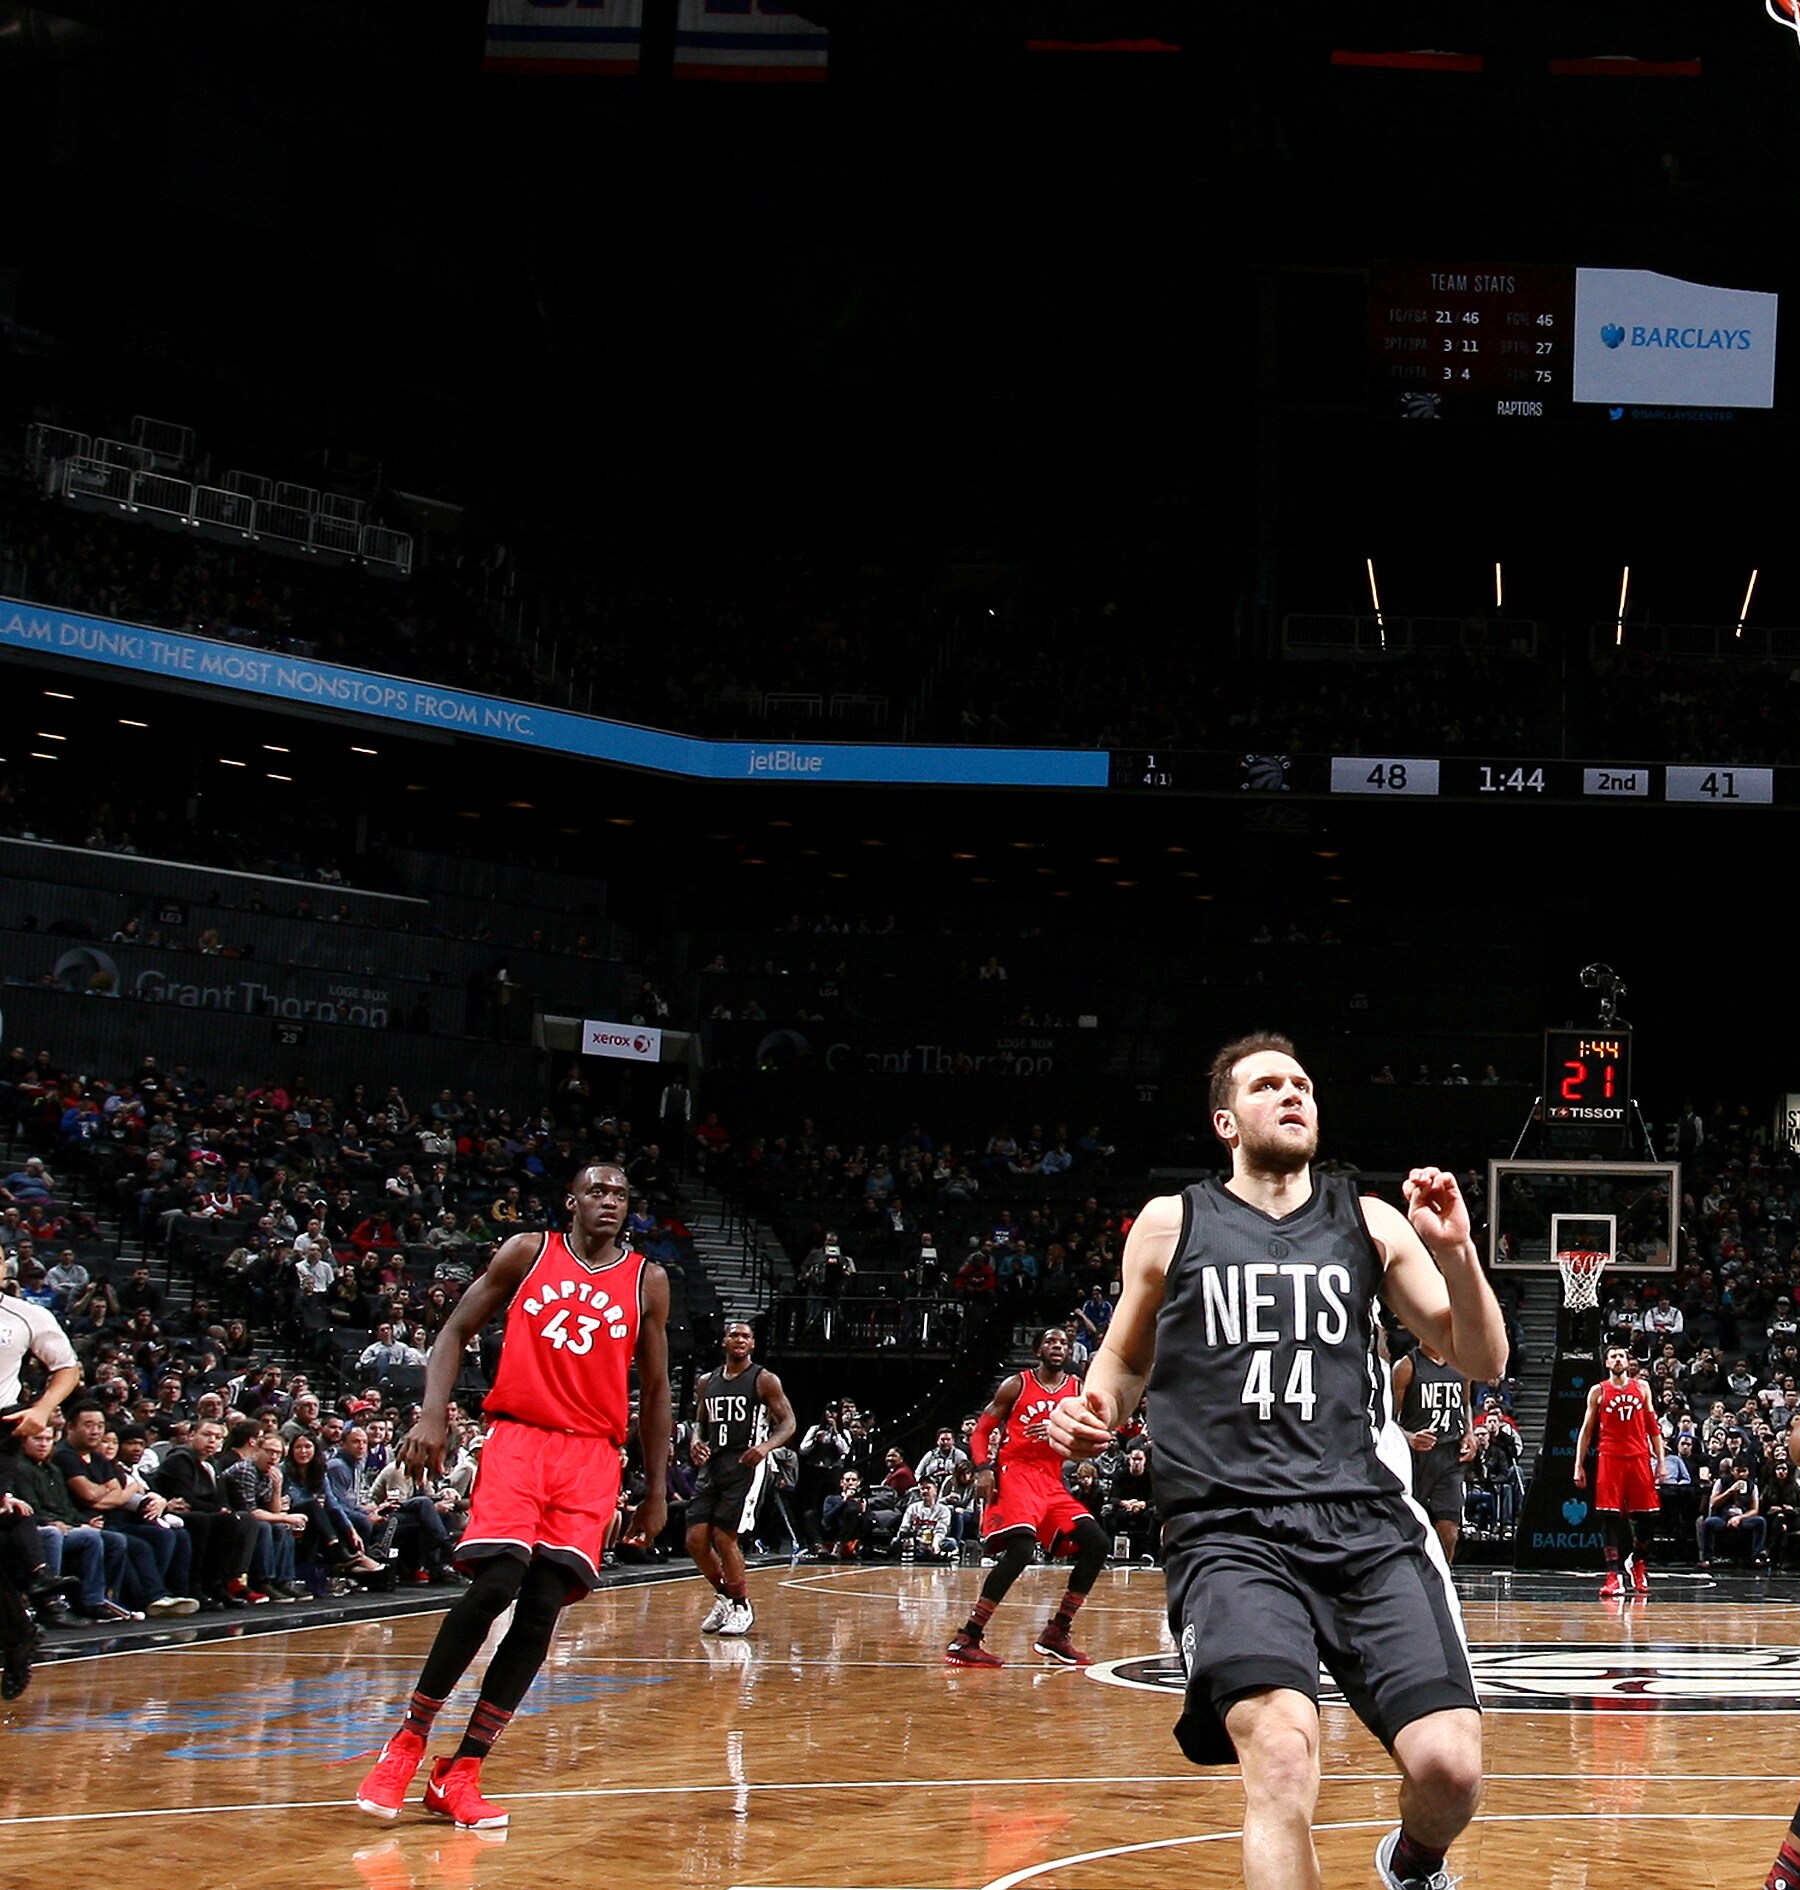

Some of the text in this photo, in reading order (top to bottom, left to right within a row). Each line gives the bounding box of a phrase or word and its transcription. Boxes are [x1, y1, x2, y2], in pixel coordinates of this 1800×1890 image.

[1430, 273, 1516, 294] TEAM STATS
[1435, 311, 1453, 324] 21
[1461, 311, 1480, 325] 46
[1535, 314, 1554, 327] 46
[1443, 339, 1453, 352] 3
[1461, 340, 1480, 353] 11
[1535, 342, 1553, 355] 27
[1631, 326, 1751, 350] BARCLAYS
[1443, 367, 1452, 380] 3
[1460, 368, 1471, 381] 4
[1534, 370, 1552, 383] 75
[1496, 400, 1543, 417] RAPTORS
[0, 613, 534, 735] AM DUNK! THE MOST NONSTOPS FROM NYC.
[748, 750, 824, 774] jetBlue
[1367, 764, 1407, 789] 48
[1478, 767, 1546, 792] 1:44
[1597, 773, 1636, 791] 2nd
[1700, 773, 1738, 798] 41
[135, 970, 237, 1010] Grant
[592, 1033, 630, 1046] xerox
[1579, 1040, 1619, 1059] 1:44
[1560, 1060, 1617, 1101] 21
[1569, 1107, 1624, 1119] TISSOT
[522, 1280, 628, 1339] RAPTORS
[1201, 1262, 1351, 1347] NETS
[540, 1309, 601, 1355] 43
[1241, 1349, 1317, 1421] 44
[1420, 1381, 1462, 1409] NETS
[705, 1396, 747, 1422] NETS
[1019, 1400, 1056, 1424] RAPT
[1428, 1409, 1451, 1433] 24
[1618, 1405, 1634, 1421] 17
[719, 1423, 728, 1446] 6
[1532, 1532, 1605, 1549] BARCLAY
